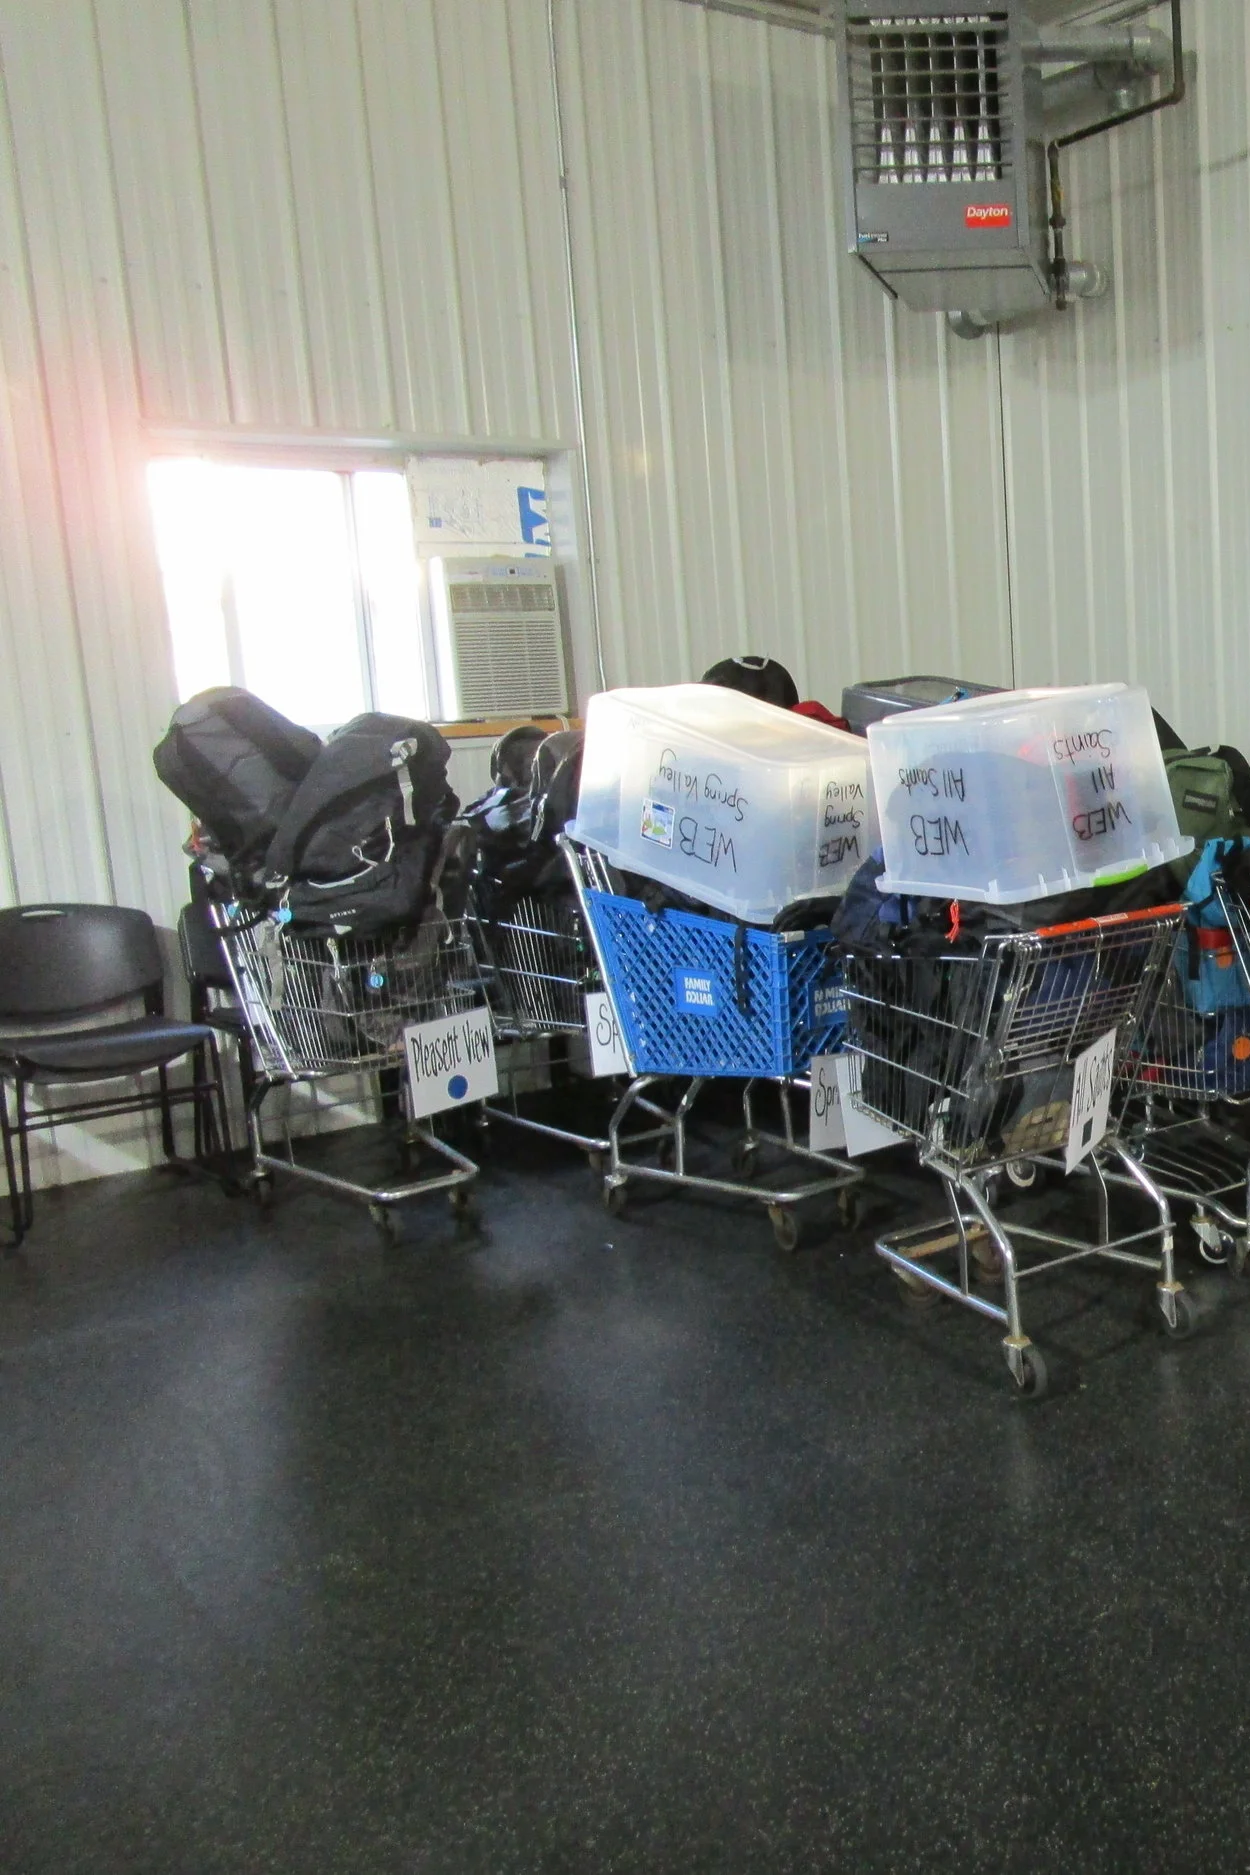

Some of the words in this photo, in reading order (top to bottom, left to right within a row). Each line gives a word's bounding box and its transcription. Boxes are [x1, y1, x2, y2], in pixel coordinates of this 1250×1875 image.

[967, 206, 1009, 219] Dayton
[1053, 729, 1113, 764] Saints
[659, 748, 699, 802] Valley
[825, 781, 864, 800] Valley
[898, 768, 940, 797] Saints
[942, 768, 966, 802] All
[1092, 764, 1115, 794] All
[704, 773, 749, 822] Spring
[824, 805, 864, 829] Spring
[1072, 801, 1133, 841] WEB
[678, 816, 738, 874] WEB
[819, 836, 860, 868] WEB
[910, 814, 970, 856] WEB
[684, 976, 711, 992] FAMILY
[685, 990, 714, 1006] DOLLAR
[463, 1019, 490, 1064] View
[815, 1068, 840, 1127] Spri
[1072, 1056, 1089, 1128] All
